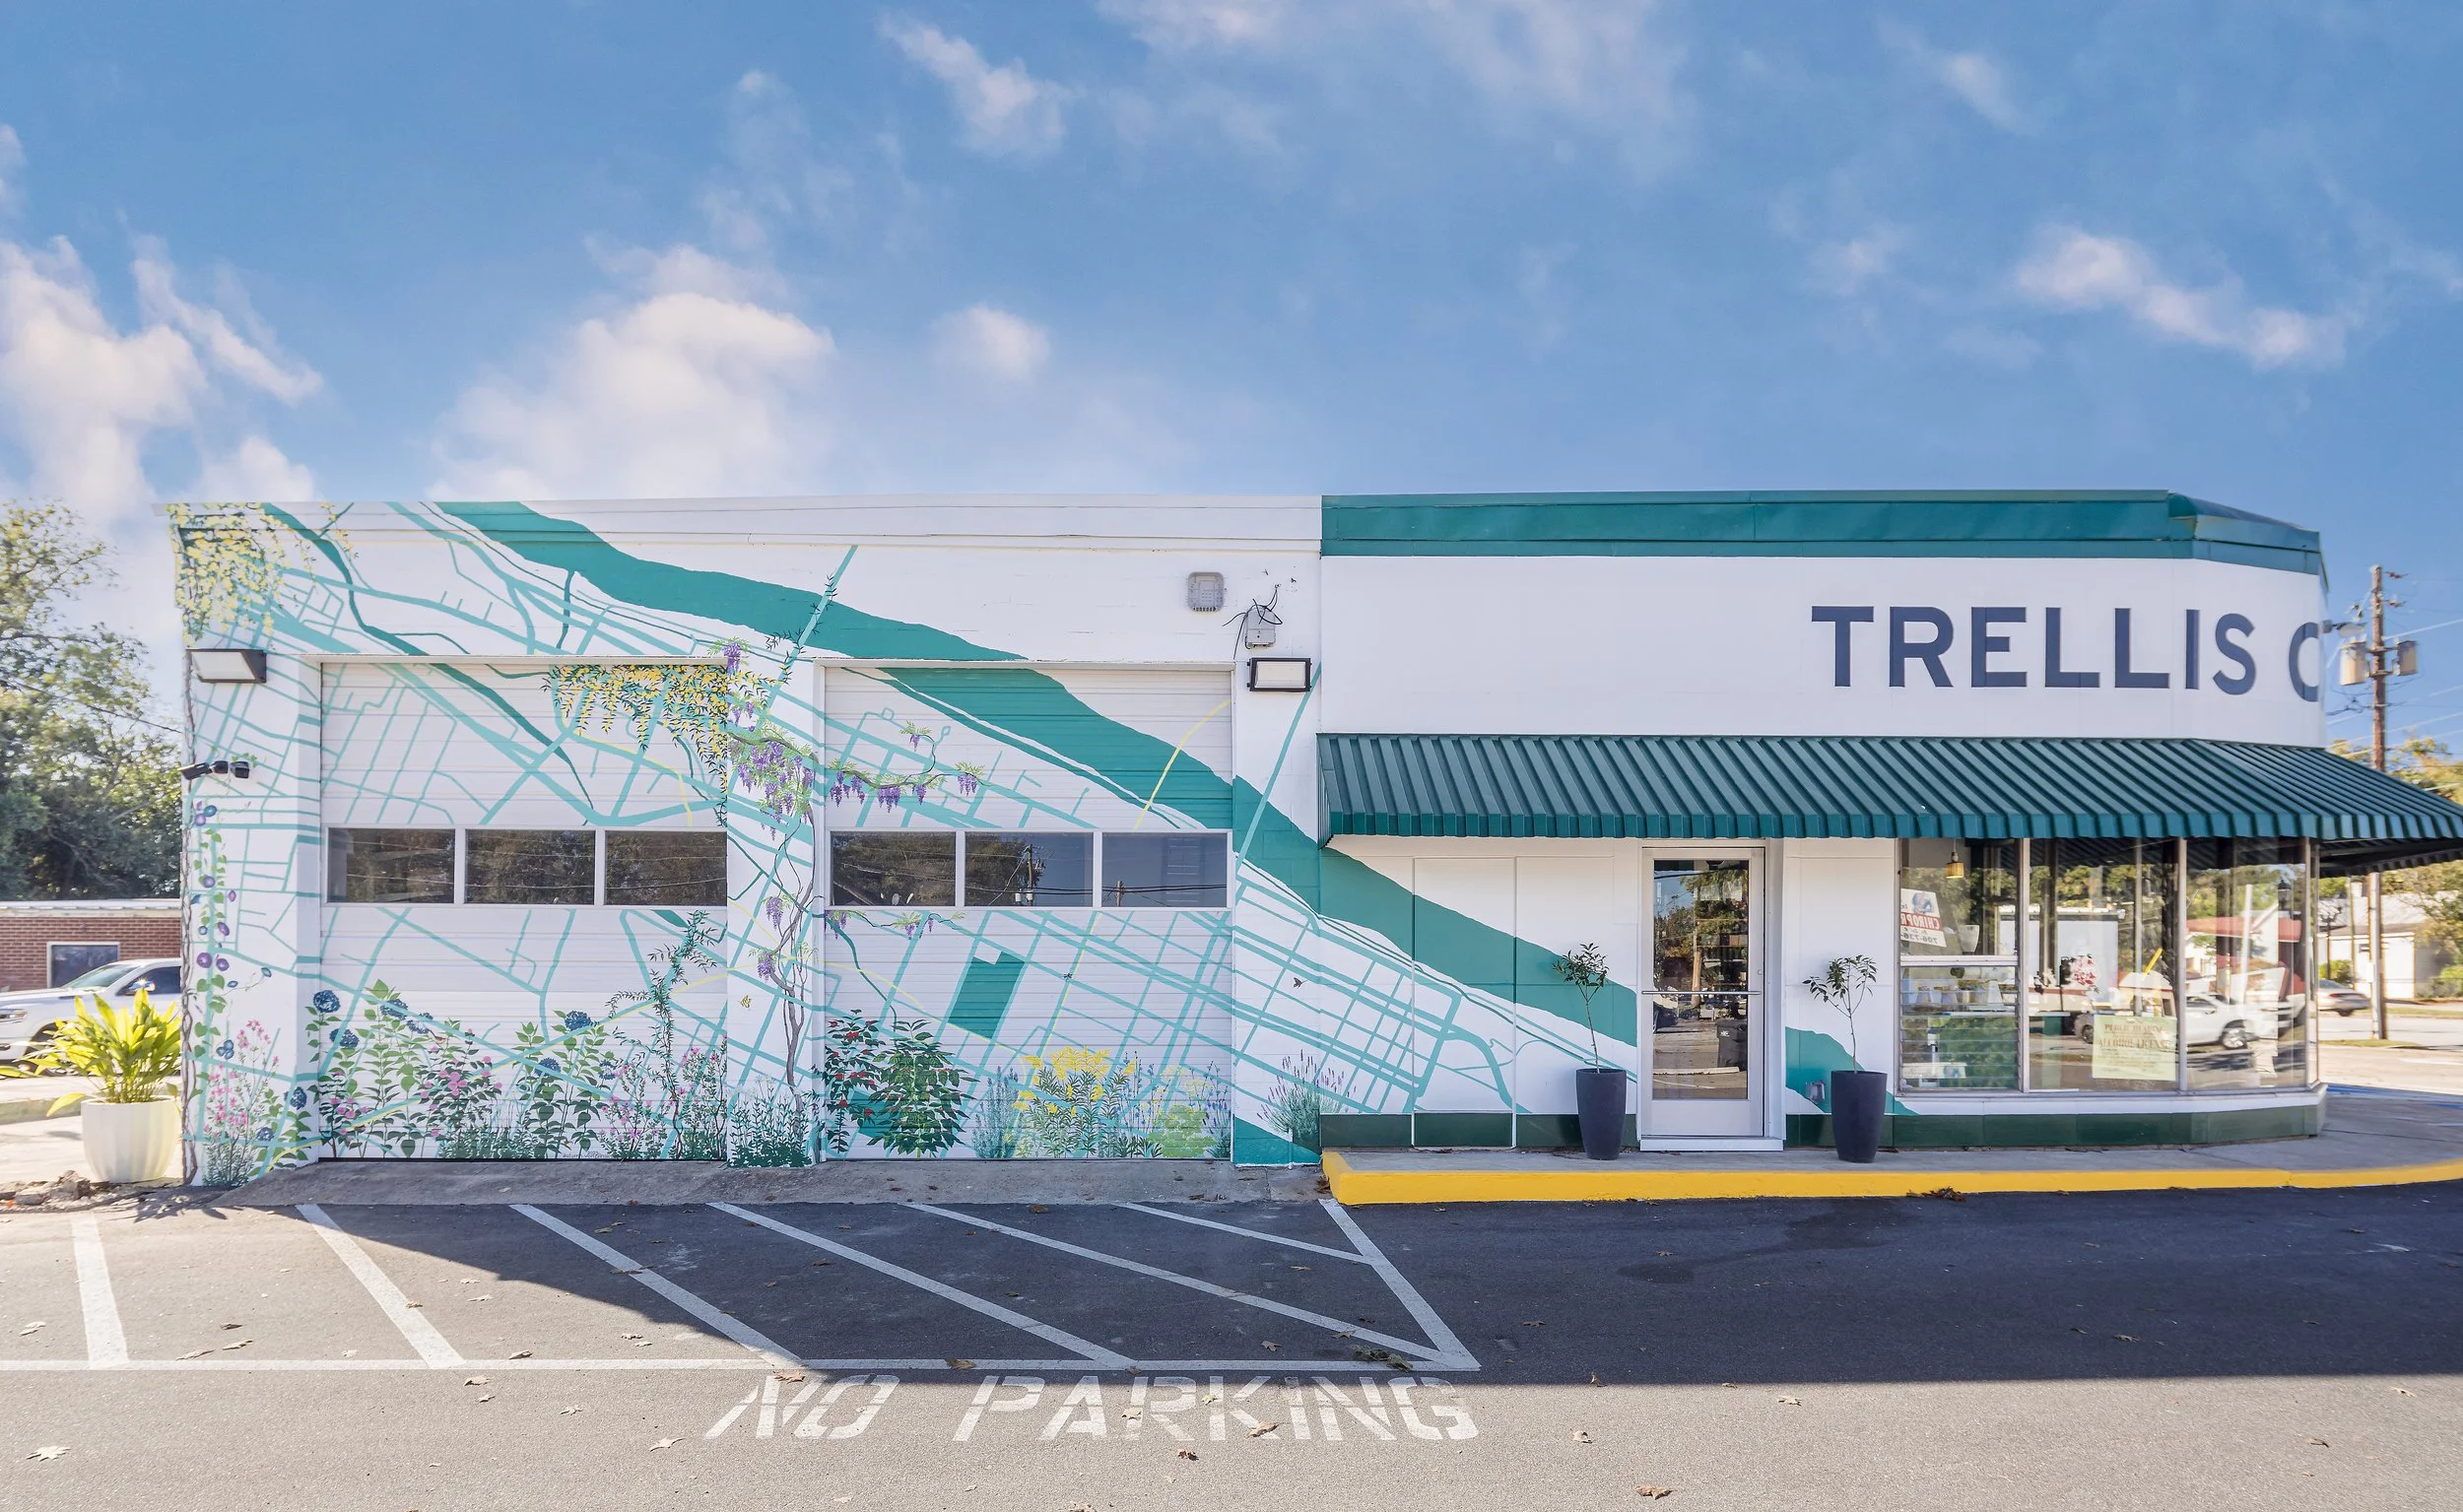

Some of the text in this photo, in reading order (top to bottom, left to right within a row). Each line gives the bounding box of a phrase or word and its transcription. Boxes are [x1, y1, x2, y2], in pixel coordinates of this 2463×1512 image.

[1811, 605, 2257, 695] TRELLIS
[702, 1374, 1479, 1442] NO PARKING
